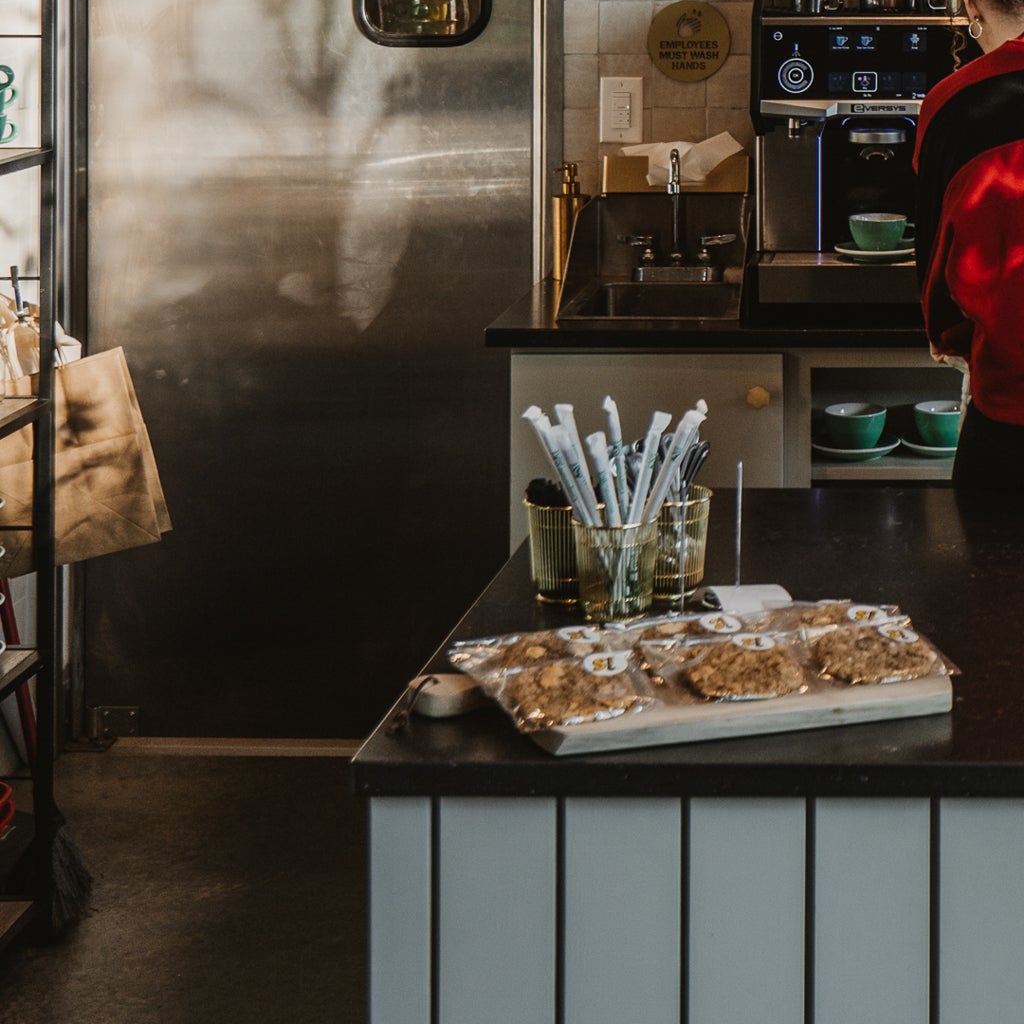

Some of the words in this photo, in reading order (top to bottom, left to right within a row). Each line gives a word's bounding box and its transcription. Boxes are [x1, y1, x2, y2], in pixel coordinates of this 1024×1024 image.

[659, 41, 718, 49] EMPLOYEES
[659, 51, 687, 60] MUST
[690, 51, 719, 60] WASH
[672, 62, 706, 70] HANDS
